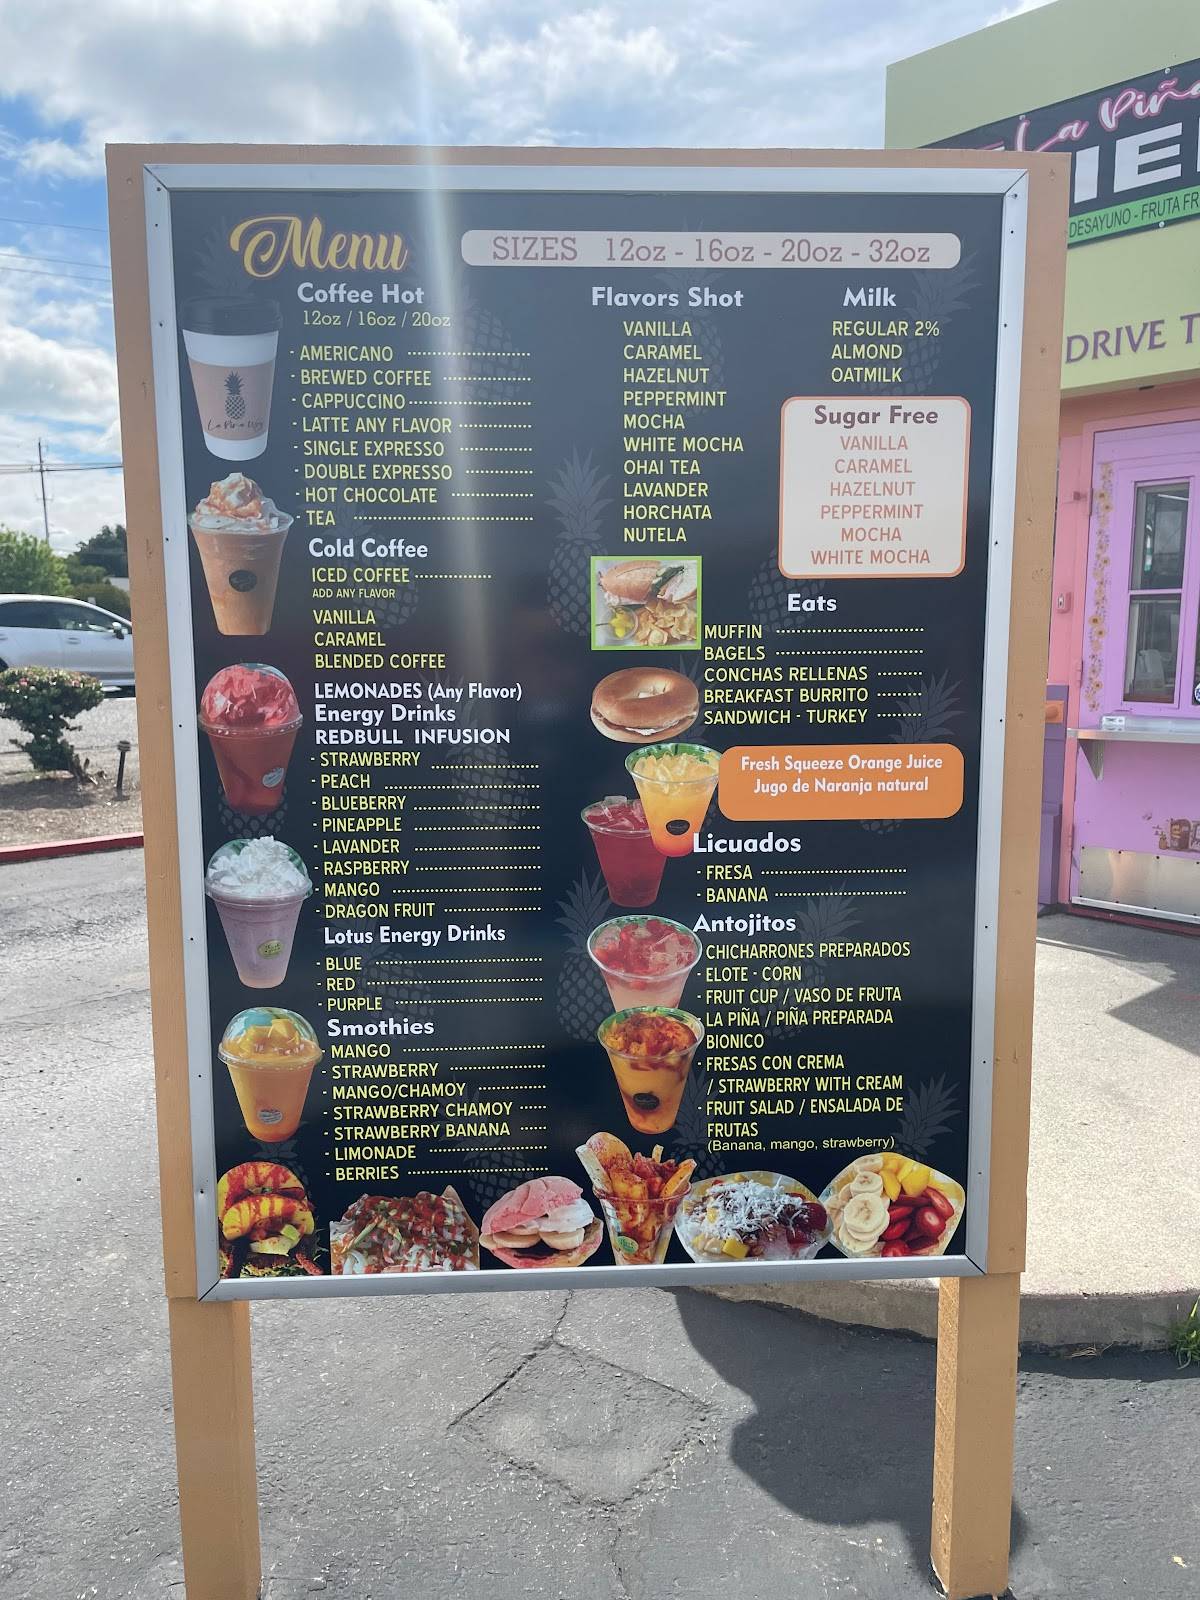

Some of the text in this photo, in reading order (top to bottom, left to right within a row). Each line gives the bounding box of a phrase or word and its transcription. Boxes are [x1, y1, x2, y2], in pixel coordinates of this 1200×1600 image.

[1069, 197, 1181, 238] DESAYUNO FRUTA
[229, 216, 408, 278] Menu
[492, 236, 931, 263] SIZES 12oz 16oz 20oz 32oz
[297, 282, 425, 303] Coffee Hot
[592, 286, 744, 308] Flavors Shot
[843, 287, 897, 307] Milk
[303, 311, 451, 327] 12oz 16oz 20oz
[623, 321, 692, 337] VANILLA
[832, 321, 940, 337] REGULAR 2%
[1065, 320, 1167, 364] DRIVE
[300, 346, 393, 361] AMERICANO
[623, 345, 702, 361] CARAMEL
[831, 344, 903, 360] ALMOND
[301, 370, 431, 386] BREWED COFFEE
[623, 368, 710, 383] HAZELNUT
[831, 367, 902, 383] OATMILK
[302, 393, 405, 409] CAPPUCCINO
[624, 391, 727, 407] PEPPERMINT
[303, 417, 452, 433] LATTE ANY FLAVOR
[624, 414, 685, 430] MOCHA
[814, 405, 939, 429] Sugar Free
[303, 441, 444, 457] SINGLE EXPRESSO
[624, 437, 744, 452] WHITE MOCHA
[840, 435, 908, 452] VANILLA
[304, 464, 452, 480] DOUBLE EXPRESSO
[624, 459, 701, 475] OHAI TEA
[834, 458, 912, 474] CARAMEL
[305, 487, 437, 503] HOT CHOCOLATE
[624, 482, 709, 498] LAVANDER
[830, 481, 916, 497] HAZELNUT
[306, 510, 336, 526] TEA
[624, 504, 712, 520] HORCHATA
[821, 504, 924, 520] PEPPERMINT
[624, 527, 687, 543] NUTELA
[841, 527, 902, 542] MOCHA
[309, 538, 428, 558] Cold Coffee
[811, 548, 930, 565] WHITE MOCHA
[312, 568, 410, 583] ICED COFFEE
[312, 588, 396, 599] ADD ANY FLAVOR
[787, 594, 837, 612] Eats
[313, 609, 376, 624] VANILLA
[314, 632, 386, 647] CARAMEL
[704, 624, 763, 639] MUFFIN
[704, 645, 765, 661] BAGELS
[315, 654, 446, 669] BLENDED COFFEE
[704, 666, 868, 682] CONCHAS RELLENAS
[315, 682, 523, 702] LEMONADES (Any Flavor)
[704, 687, 868, 704] BREAKFAST BURRITO
[315, 704, 457, 726] Energy Drinks
[704, 709, 868, 725] SANDWICH TURKEY
[315, 728, 511, 745] REDBULL INFUSION
[320, 752, 421, 767] STRAWBERRY
[741, 753, 943, 774] Fresh Squeeze Orange Juice
[321, 774, 371, 789] PEACH
[753, 776, 929, 796] Jugo de Naranja natural
[321, 796, 406, 811] BLUEBERRY
[322, 818, 402, 832] PINEAPPLE
[323, 839, 400, 854] LAVANDER
[693, 832, 801, 853] Licuados
[324, 861, 410, 876] RASPBERRY
[706, 865, 753, 880] FRESA
[325, 882, 380, 897] MANGO
[706, 887, 768, 903] BANANA
[325, 902, 435, 918] DRAGON FRUIT
[693, 914, 797, 936] Antojitos
[324, 924, 506, 947] Lotus Energy Drinks
[706, 942, 910, 960] CHICHARRONES PREPARADOS
[326, 957, 362, 971] BLUE
[706, 966, 802, 983] ELOTE CORN
[326, 977, 355, 991] RED
[327, 997, 383, 1011] PURPLE
[706, 987, 901, 1005] FRUIT CUP VASO DE FRUTA
[706, 1006, 893, 1027] LA PIÑA PIÑA PREPARADA
[327, 1017, 435, 1037] Smothies
[706, 1034, 764, 1050] BIONICO
[331, 1043, 391, 1058] MANGO
[332, 1063, 439, 1079] STRAWBERRY
[706, 1054, 845, 1072] FRESAS CON CREMA
[332, 1083, 466, 1100] MANGO/CHAMOY
[719, 1075, 903, 1094] STRAWBERRY WITH CREAM
[333, 1101, 513, 1120] STRAWBERRY CHAMOY
[706, 1097, 904, 1117] FRUIT SALAD ENSALADA DE
[334, 1122, 510, 1140] STRAWBERRY BANANA
[707, 1122, 758, 1138] FRUTAS
[335, 1145, 417, 1160] LIMONADE
[707, 1135, 895, 1154] (Banana, mango, strawberry)
[336, 1166, 400, 1181] BERRIES
